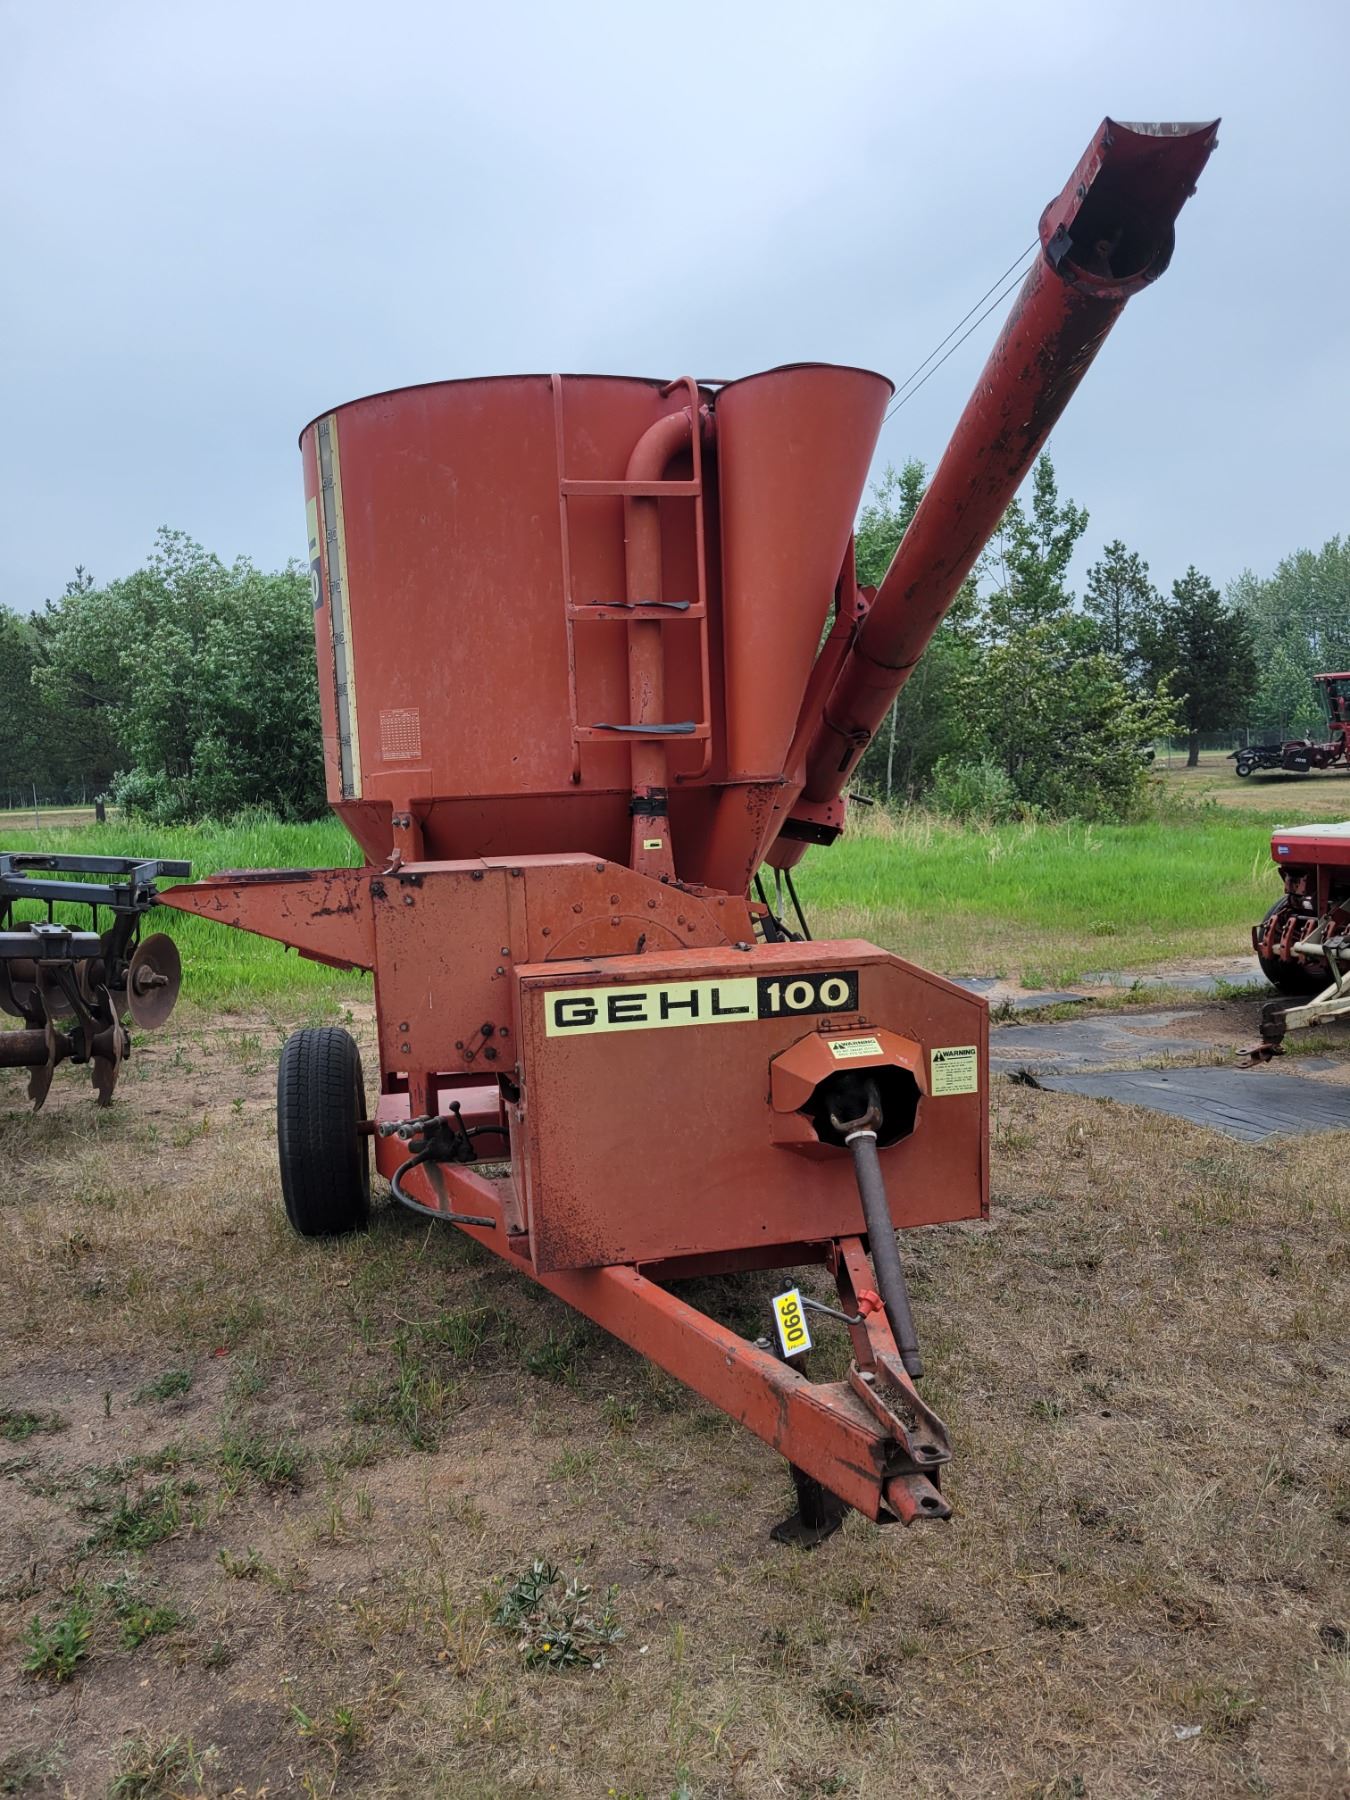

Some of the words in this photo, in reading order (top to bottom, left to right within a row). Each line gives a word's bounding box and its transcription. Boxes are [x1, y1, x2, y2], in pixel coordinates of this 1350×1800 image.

[553, 987, 750, 1028] GEHL
[766, 977, 850, 1012] 100
[942, 1048, 976, 1057] WARNING
